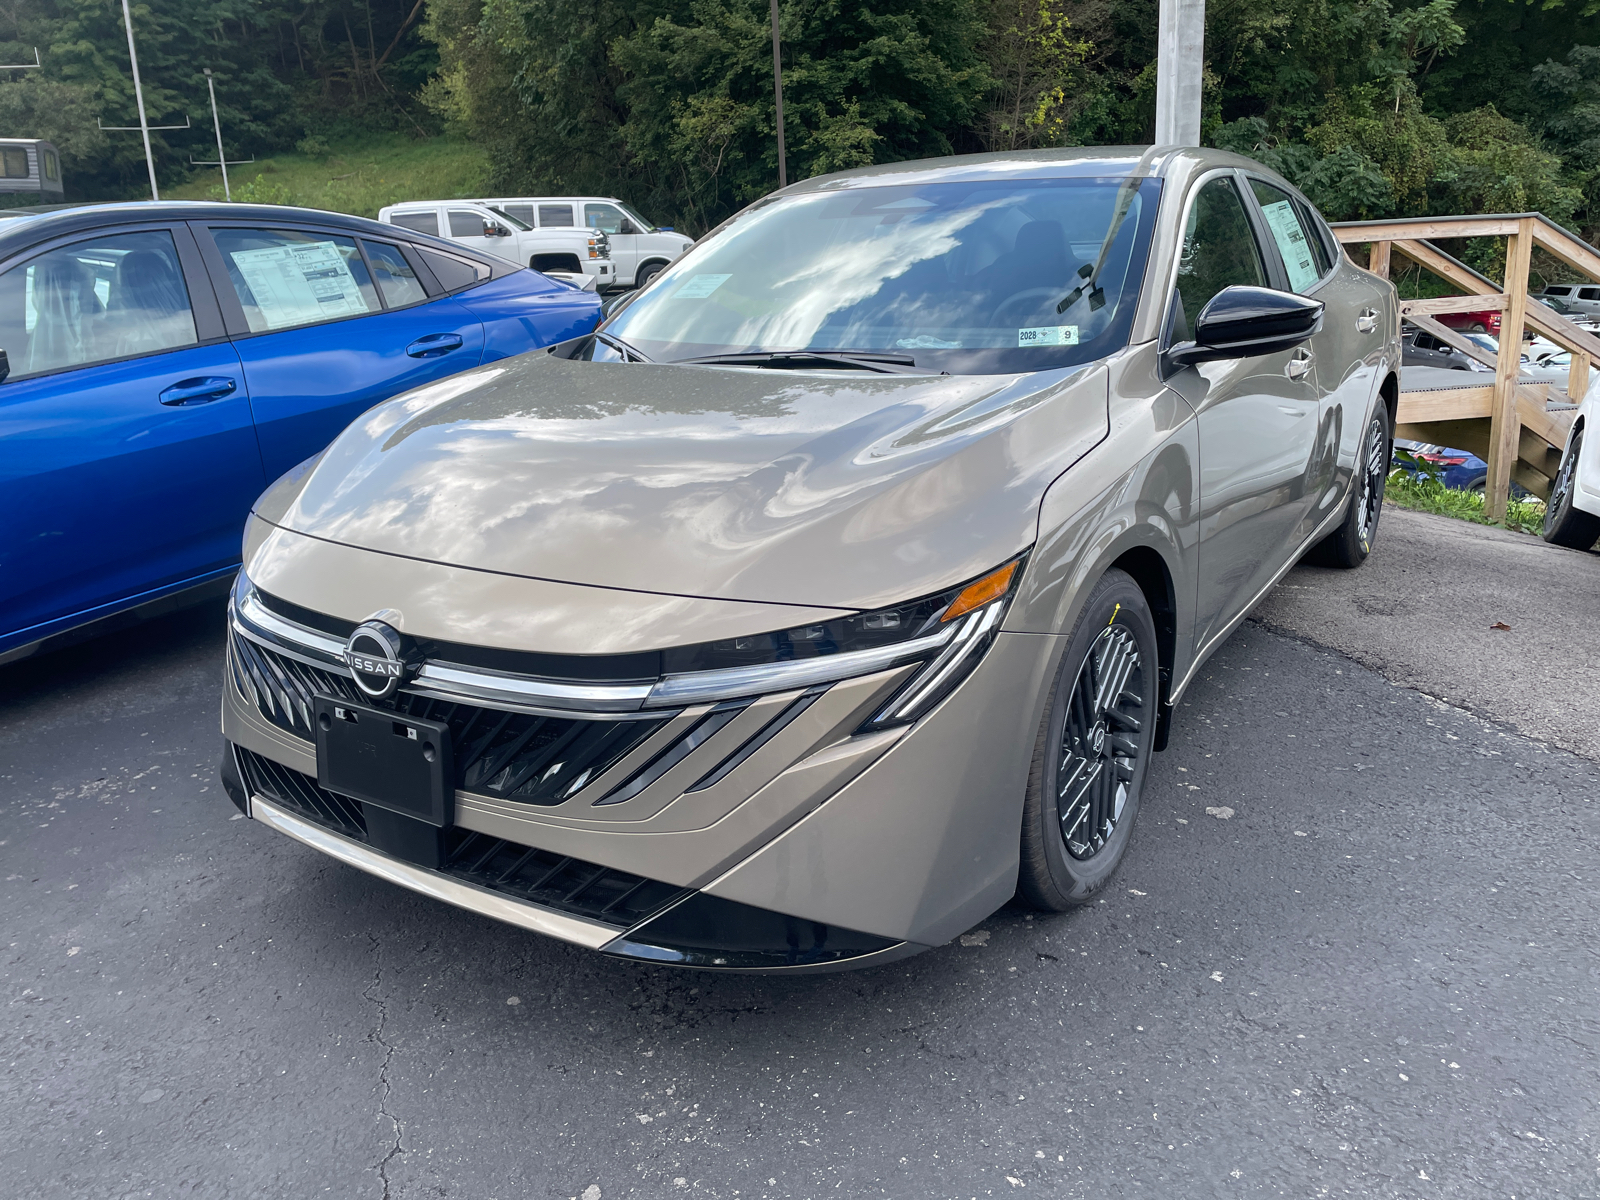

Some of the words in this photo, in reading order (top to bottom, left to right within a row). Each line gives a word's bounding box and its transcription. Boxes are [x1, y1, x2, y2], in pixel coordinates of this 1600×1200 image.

[1020, 331, 1037, 340] 2028
[1064, 330, 1071, 339] 9
[343, 652, 400, 676] NISSAN
